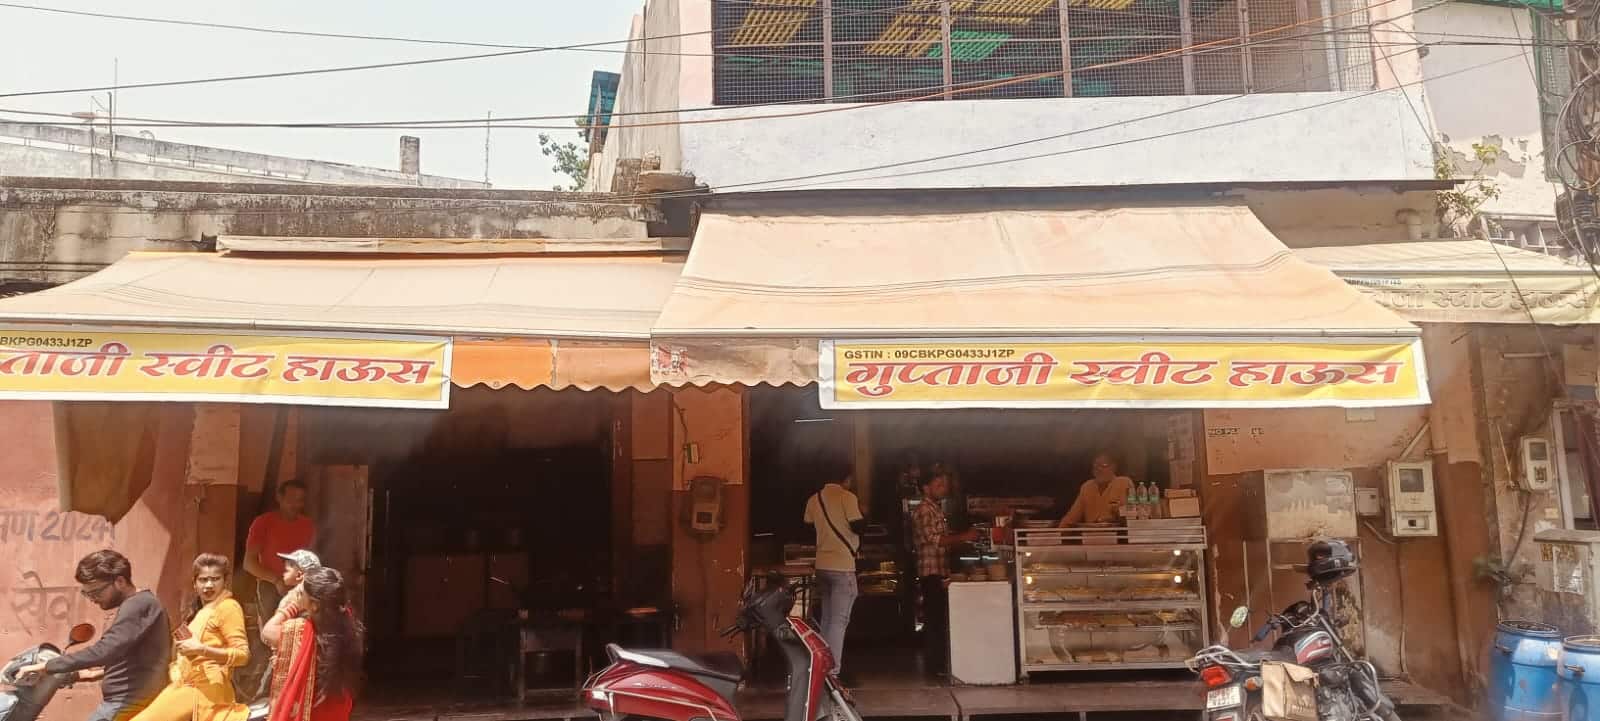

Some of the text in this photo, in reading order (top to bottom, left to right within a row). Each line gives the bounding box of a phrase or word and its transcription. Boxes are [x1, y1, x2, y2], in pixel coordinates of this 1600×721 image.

[140, 344, 275, 378] स्वीट
[283, 356, 436, 384] हाऊस
[844, 349, 883, 360] GSTIN
[894, 348, 1016, 360] 09CBKPG0433J1ZP
[845, 351, 1404, 397] गुप्ताजी स्वीट हाऊस
